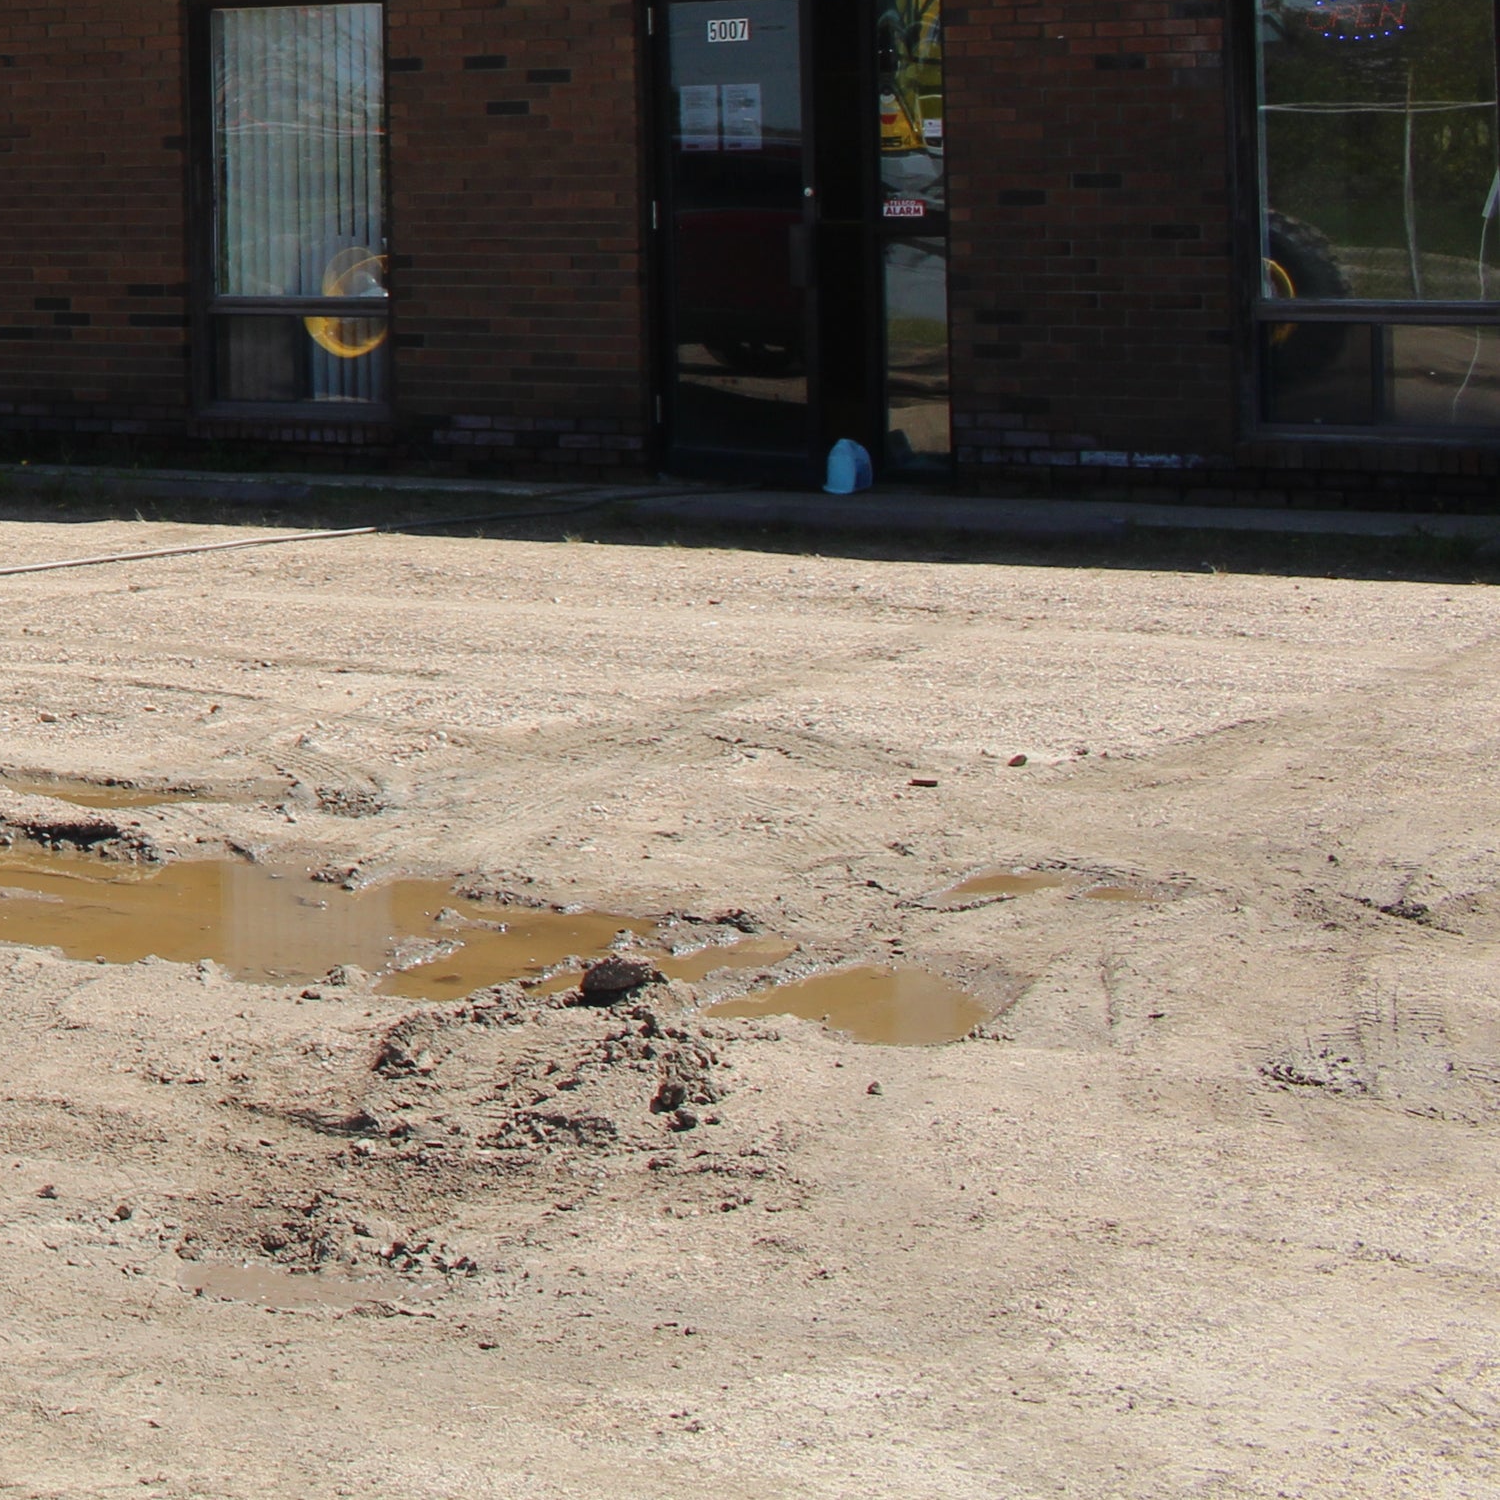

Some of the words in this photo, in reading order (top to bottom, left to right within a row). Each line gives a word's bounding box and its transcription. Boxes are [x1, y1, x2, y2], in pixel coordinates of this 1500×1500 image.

[1305, 3, 1408, 30] OPEN
[709, 20, 747, 41] 5007
[886, 206, 921, 216] ALARM
